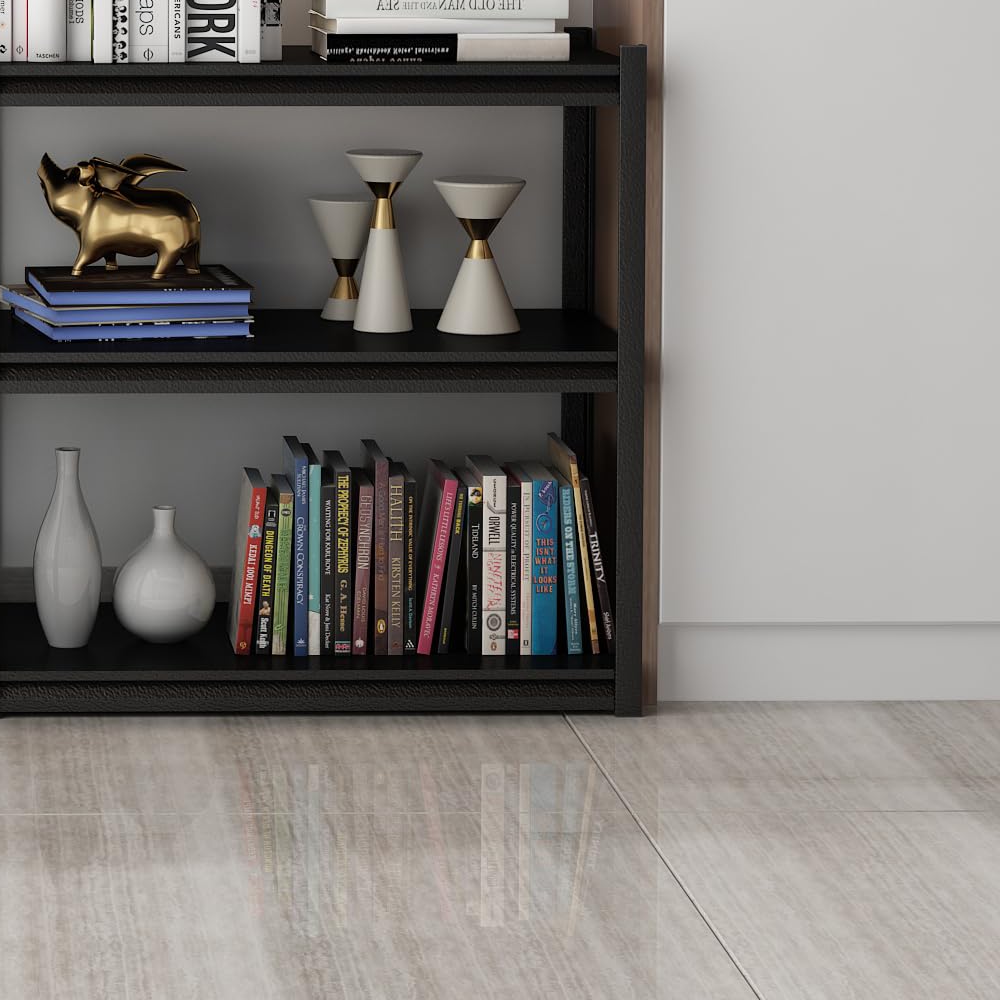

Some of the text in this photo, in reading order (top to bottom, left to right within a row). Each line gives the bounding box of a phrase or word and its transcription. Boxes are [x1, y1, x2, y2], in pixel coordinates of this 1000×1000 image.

[338, 475, 349, 573] THE PROPHECY OF ZEPHYRUS
[562, 489, 572, 525] RIDERS
[357, 495, 372, 569] GEOSYNCHRON
[436, 492, 453, 561] LIFE'S LITTLE LESSONS
[472, 524, 480, 559] TIDELAND
[489, 516, 500, 544] ORWELL
[564, 526, 573, 539] ON
[262, 530, 274, 597] DUNGEON OF DEATH
[391, 485, 404, 628] HALITH KIRSTEN KELLY
[566, 541, 574, 561] THE
[589, 531, 606, 584] TRINITY
[244, 544, 257, 604] KEDAI 1001 MIMPI
[340, 580, 347, 590] G.
[534, 576, 557, 584] LOOKS
[567, 562, 576, 594] STORM
[340, 593, 347, 603] A.
[424, 573, 439, 638] KATHRYN MORAVEC
[260, 618, 269, 632] Scott
